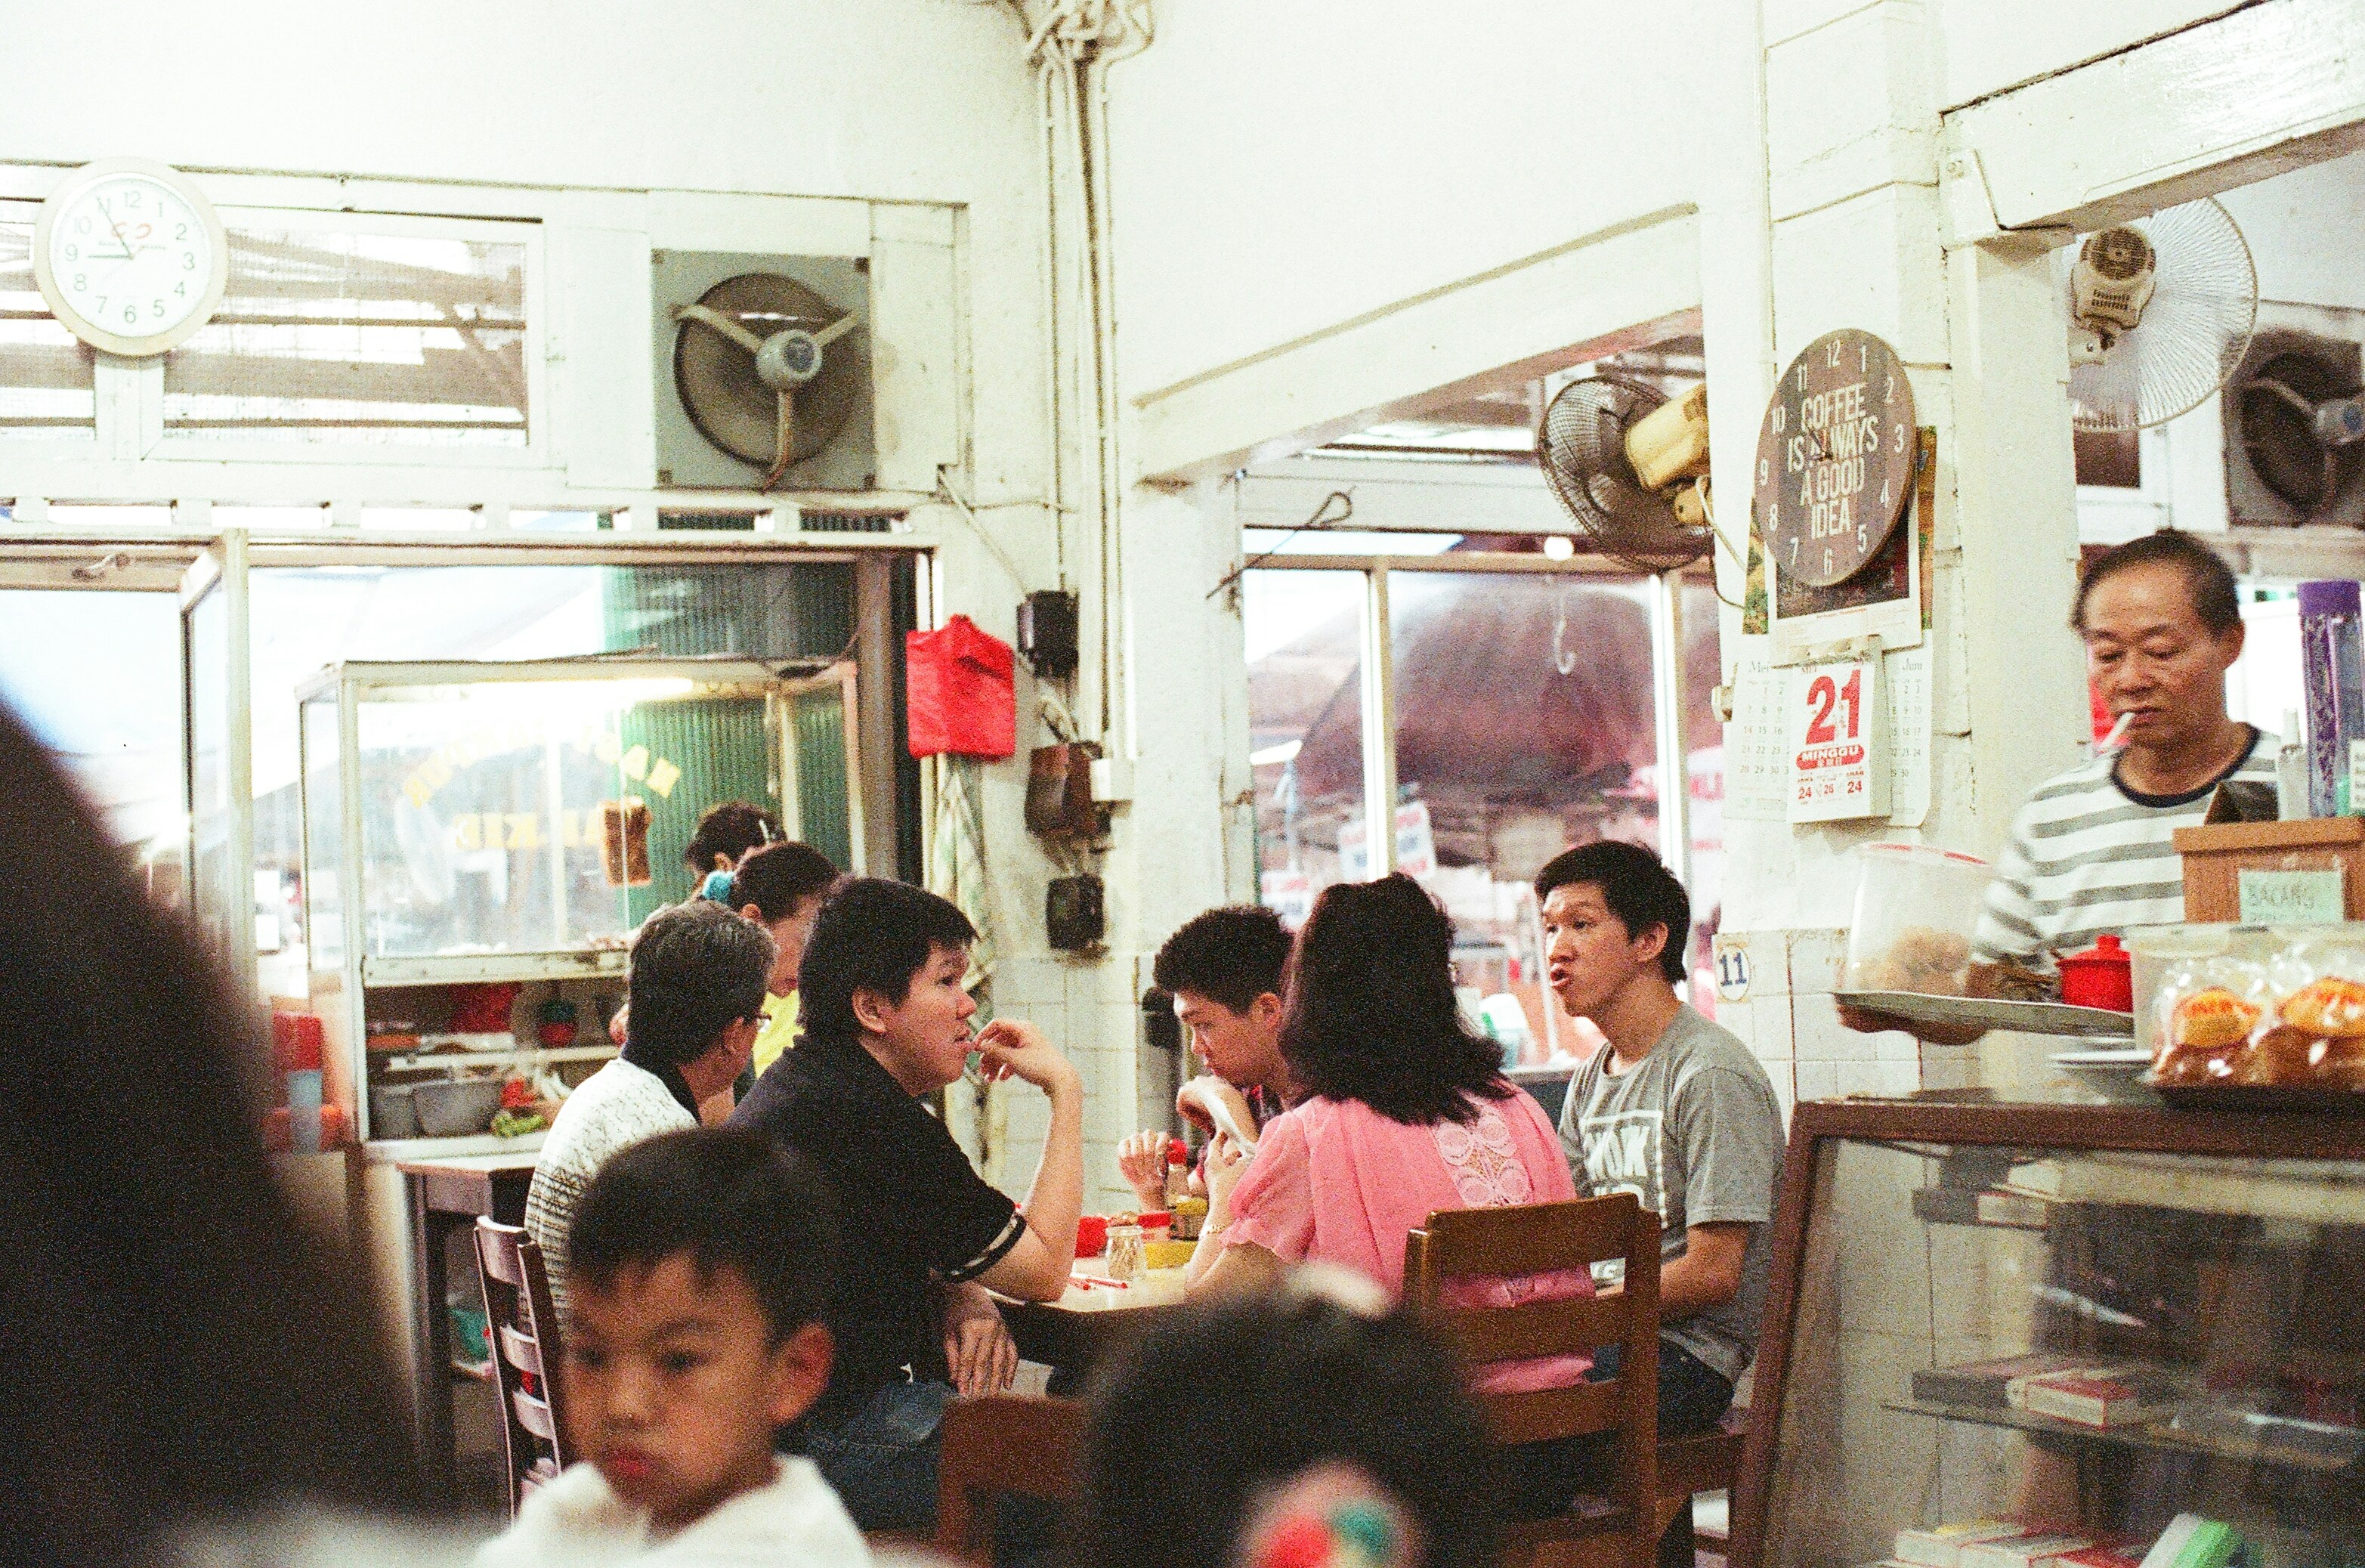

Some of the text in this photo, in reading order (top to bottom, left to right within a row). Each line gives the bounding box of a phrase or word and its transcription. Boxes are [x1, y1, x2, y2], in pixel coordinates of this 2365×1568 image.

[124, 190, 141, 209] 12
[158, 201, 163, 218] 1
[175, 223, 187, 241] 2
[64, 243, 78, 262] 9
[181, 252, 195, 271] 3
[73, 273, 87, 292] 8
[174, 280, 185, 297] 4
[95, 295, 108, 314] 7
[123, 305, 137, 324] 6
[153, 298, 165, 317] 5
[1826, 339, 1841, 369] 12
[1860, 345, 1867, 373] 1
[1797, 363, 1808, 392] 11
[1885, 376, 1894, 404] 2
[1771, 406, 1786, 435] 10
[1801, 382, 1867, 431] COFFEE
[1894, 423, 1905, 453] 3
[1788, 436, 1804, 472] IS
[1759, 458, 1769, 487] 9
[1800, 457, 1865, 506] A GOOD
[1880, 479, 1890, 509] 4
[1768, 503, 1779, 532] 8
[1811, 497, 1850, 540] IDEA
[1789, 537, 1800, 565] 7
[1857, 524, 1868, 553] 5
[1822, 547, 1835, 576] 6
[1806, 669, 1861, 745] 21
[1798, 787, 1812, 799] 24
[1847, 780, 1862, 793] 24
[1719, 952, 1747, 987] 11
